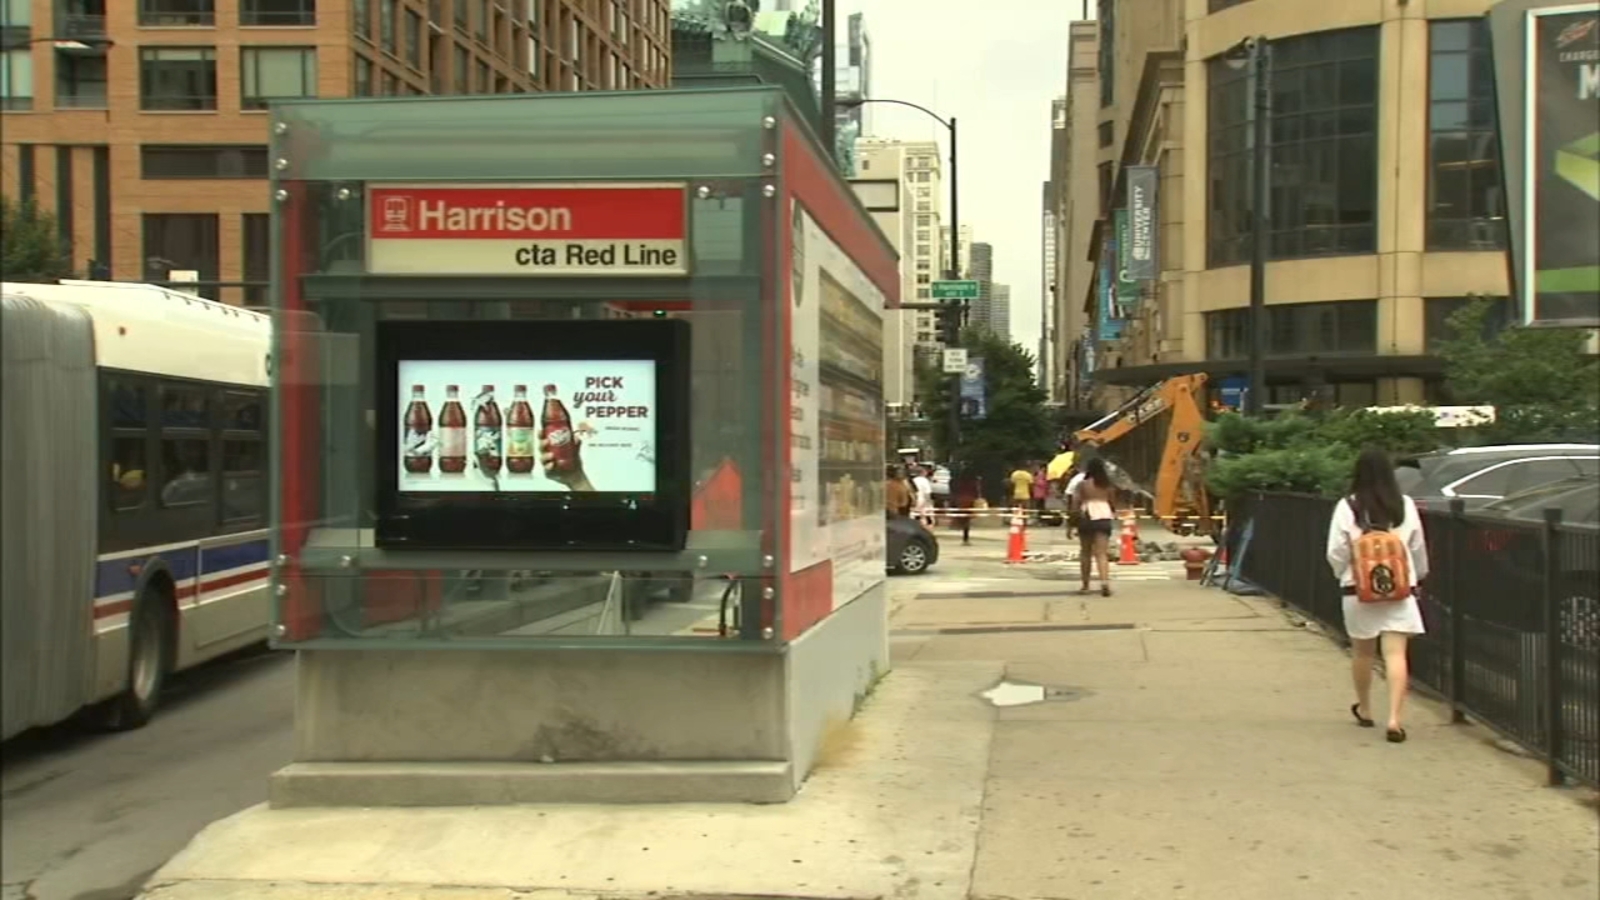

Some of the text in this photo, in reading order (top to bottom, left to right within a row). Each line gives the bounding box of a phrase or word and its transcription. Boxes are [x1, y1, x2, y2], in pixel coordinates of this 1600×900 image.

[418, 199, 572, 231] Harrison
[1133, 185, 1144, 248] UNIVERSITY
[515, 244, 677, 266] cta Red Line
[585, 376, 624, 389] PICK
[573, 389, 618, 409] your
[585, 405, 649, 418] PEPPER
